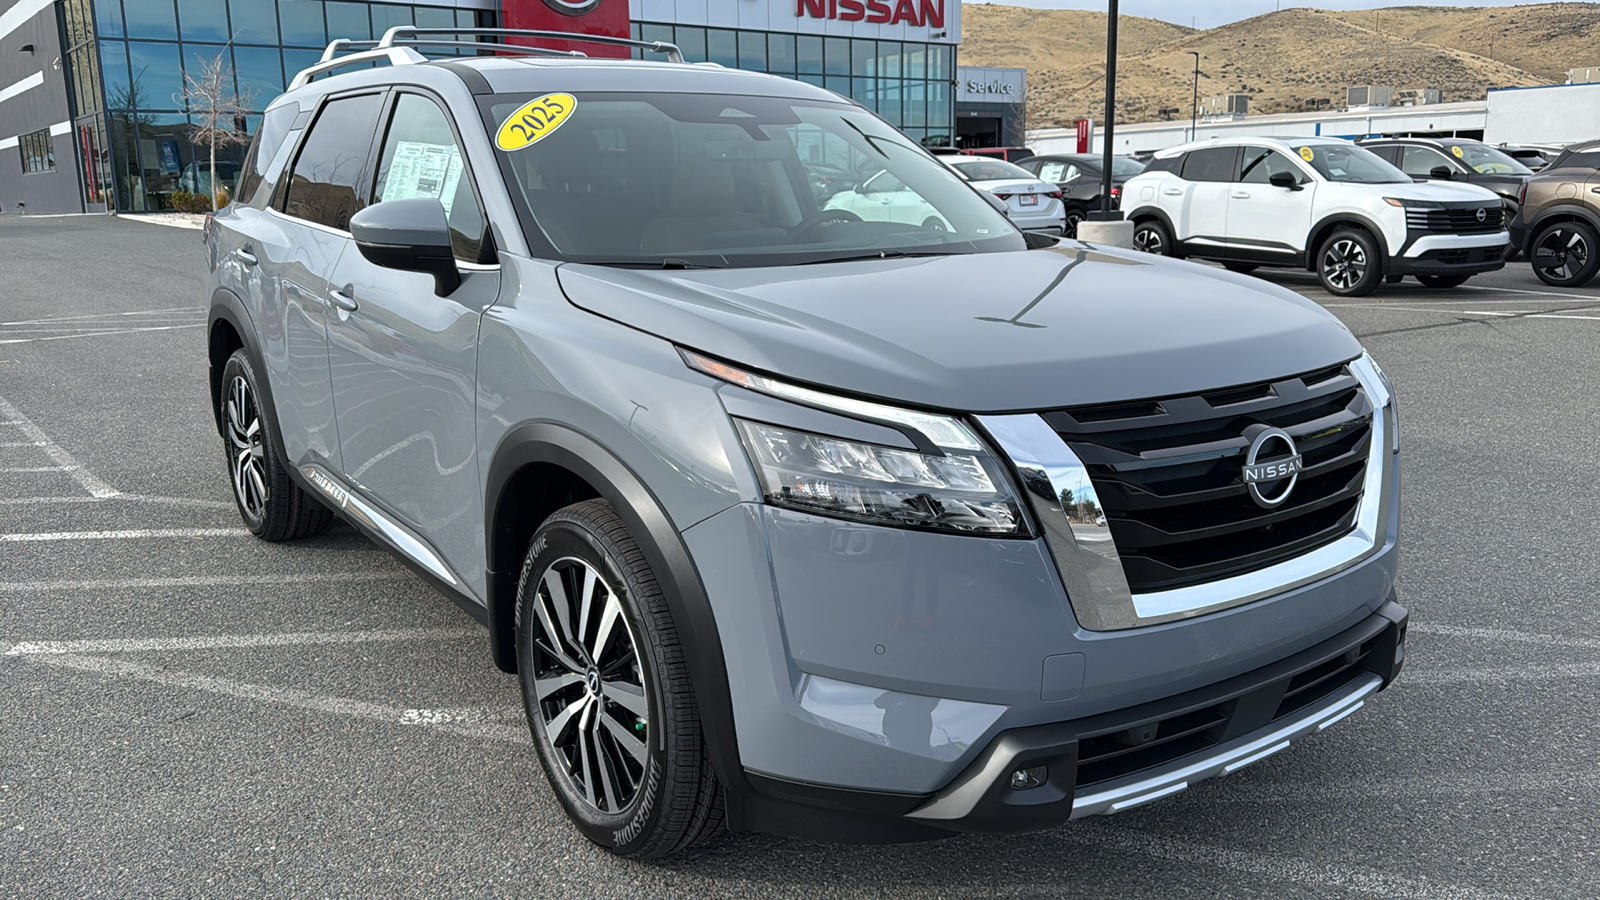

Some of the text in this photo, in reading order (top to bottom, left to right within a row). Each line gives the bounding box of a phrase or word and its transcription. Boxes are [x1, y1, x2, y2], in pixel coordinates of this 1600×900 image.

[797, 0, 945, 28] NISSAN
[968, 79, 1014, 94] Service
[510, 97, 565, 142] 2025
[1245, 459, 1302, 481] NISSAN
[612, 752, 663, 847] BRIDGESTONE
